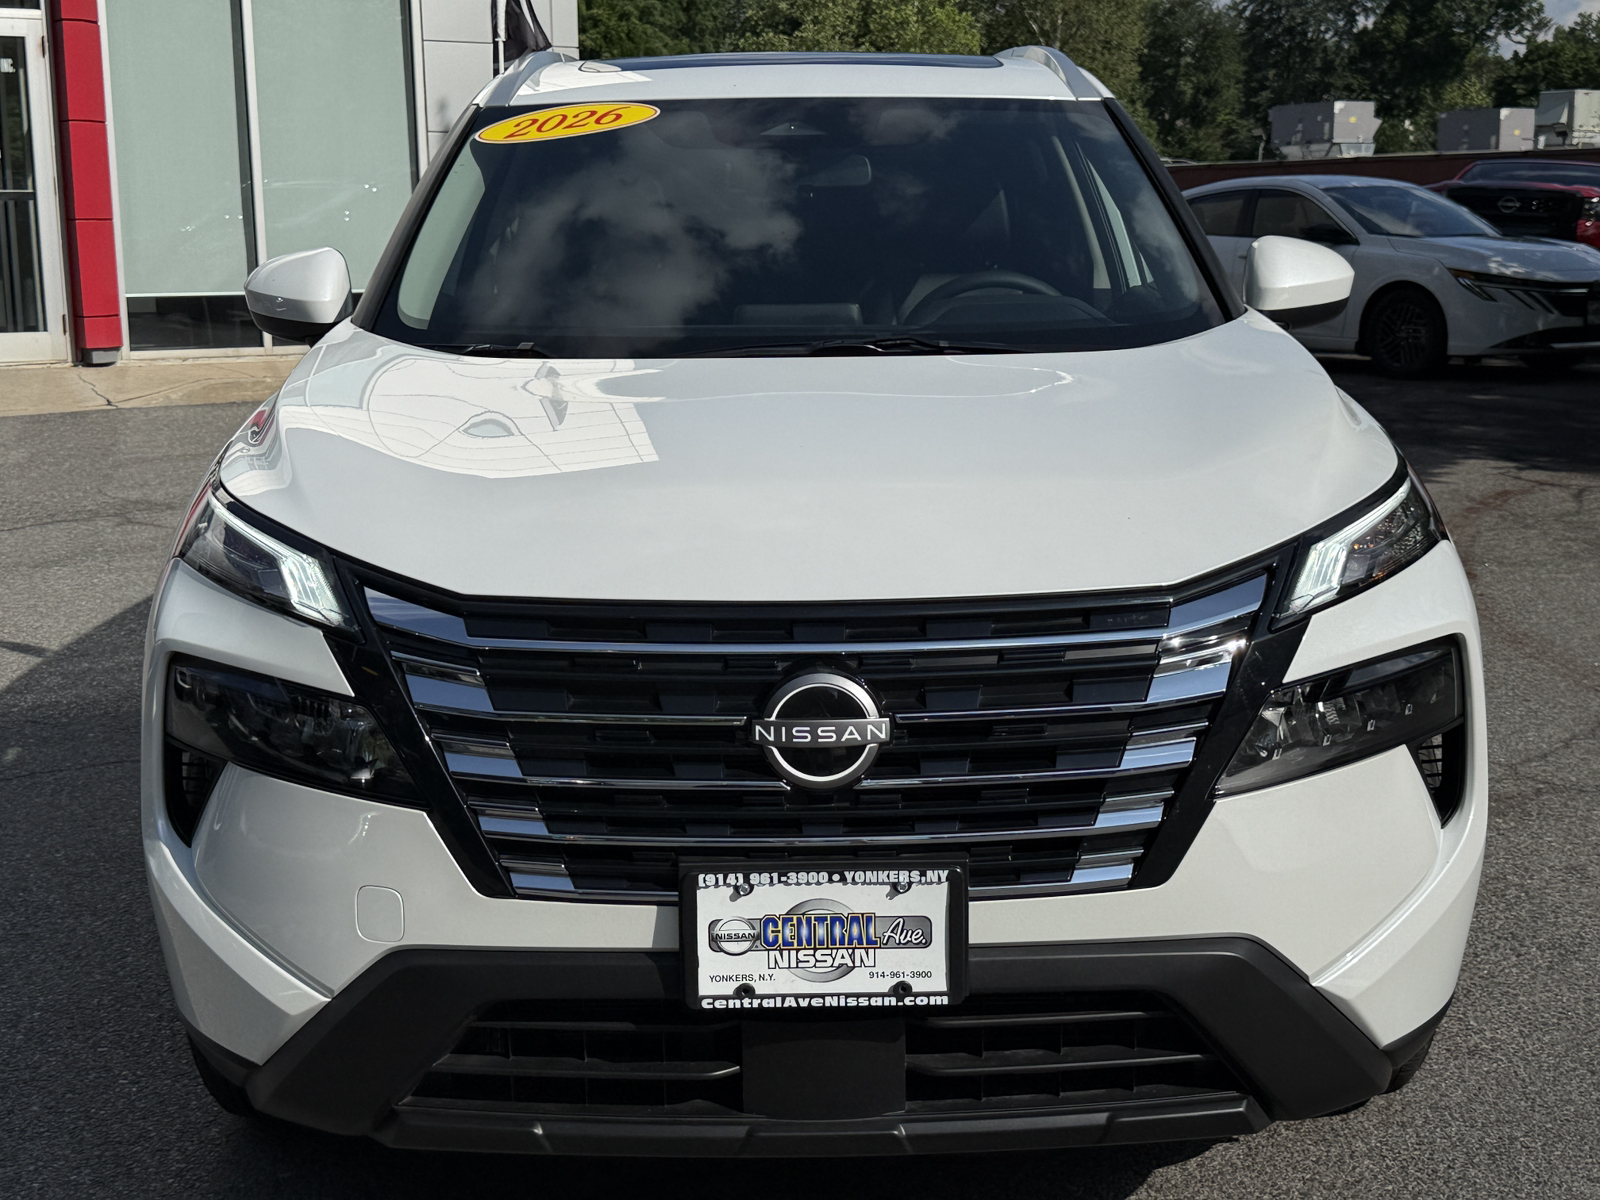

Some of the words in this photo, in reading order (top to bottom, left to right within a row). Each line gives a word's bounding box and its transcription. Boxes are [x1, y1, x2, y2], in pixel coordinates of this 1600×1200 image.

[503, 106, 632, 139] 2026
[755, 723, 886, 742] NISSAN
[749, 872, 829, 885] 961-3900
[715, 932, 756, 940] NISSAN
[760, 913, 881, 950] CENTRAL
[882, 917, 927, 945] Ave.
[768, 948, 876, 969] NISSAN
[709, 974, 757, 983] YONKERS,
[758, 973, 776, 982] N.Y.
[868, 970, 933, 979] 914-961-3900
[701, 995, 949, 1009] CentralAveNissan.com
